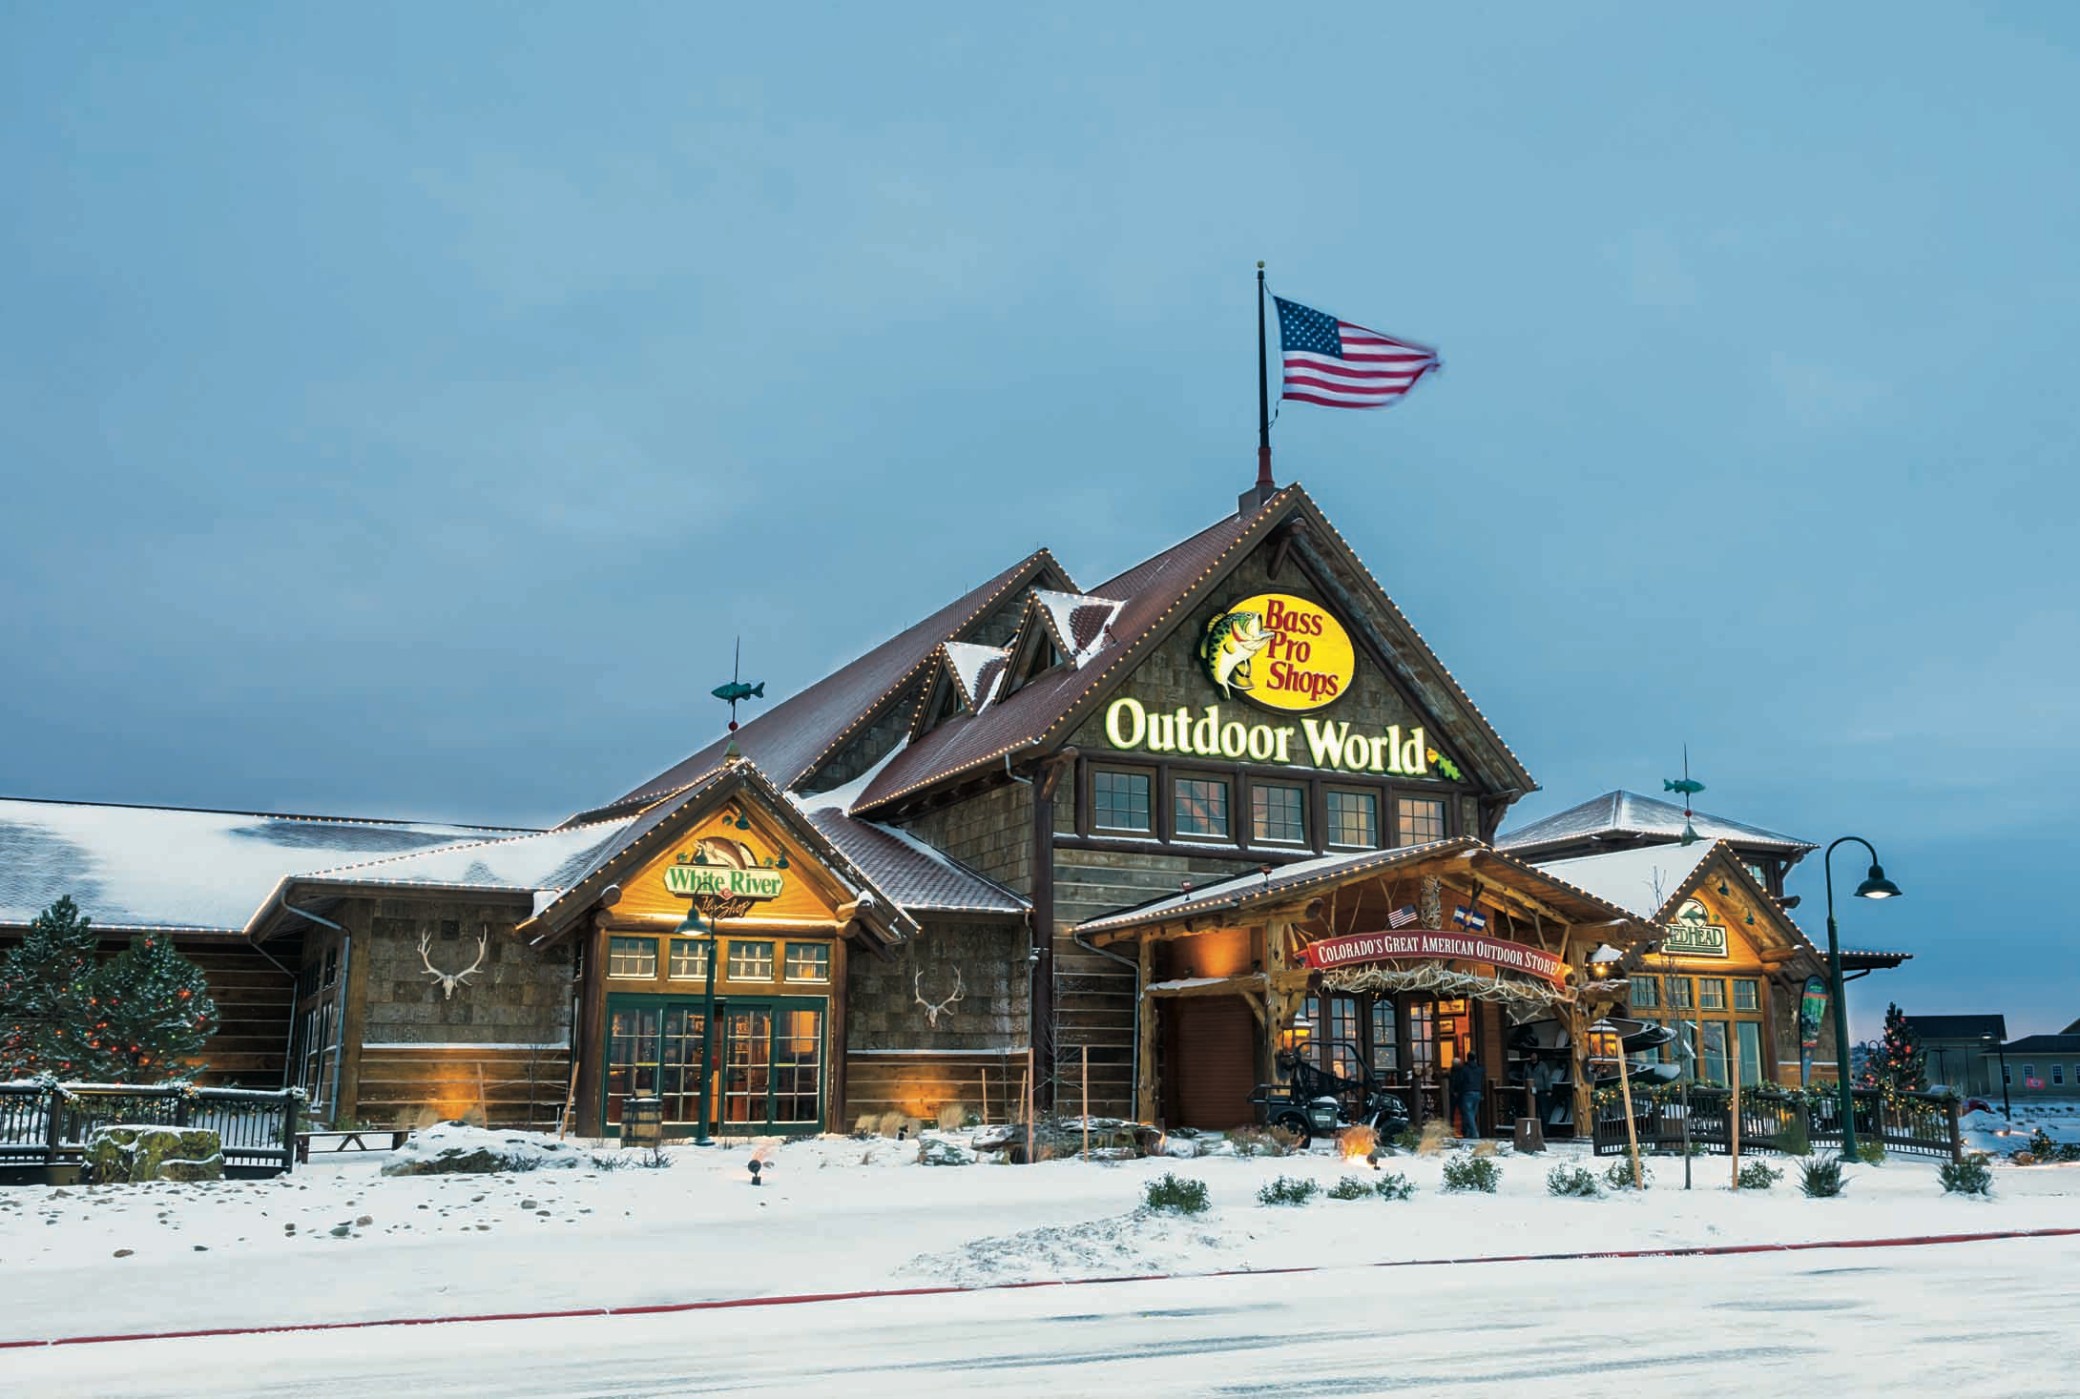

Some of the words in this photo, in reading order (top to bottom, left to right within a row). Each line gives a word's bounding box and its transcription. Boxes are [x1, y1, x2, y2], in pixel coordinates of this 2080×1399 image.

[1264, 598, 1324, 637] Bass
[1266, 631, 1311, 663] Pro
[1266, 661, 1339, 701] Shops
[1105, 697, 1295, 763] Outdoor
[1300, 717, 1428, 775] World
[669, 868, 725, 892] White
[730, 870, 782, 895] River
[716, 898, 751, 920] Shop
[1318, 937, 1384, 964] COLORADO'S
[1384, 935, 1420, 954] GREAT
[1421, 935, 1474, 957] AMERICAN
[1476, 940, 1523, 966] OUTDOOR
